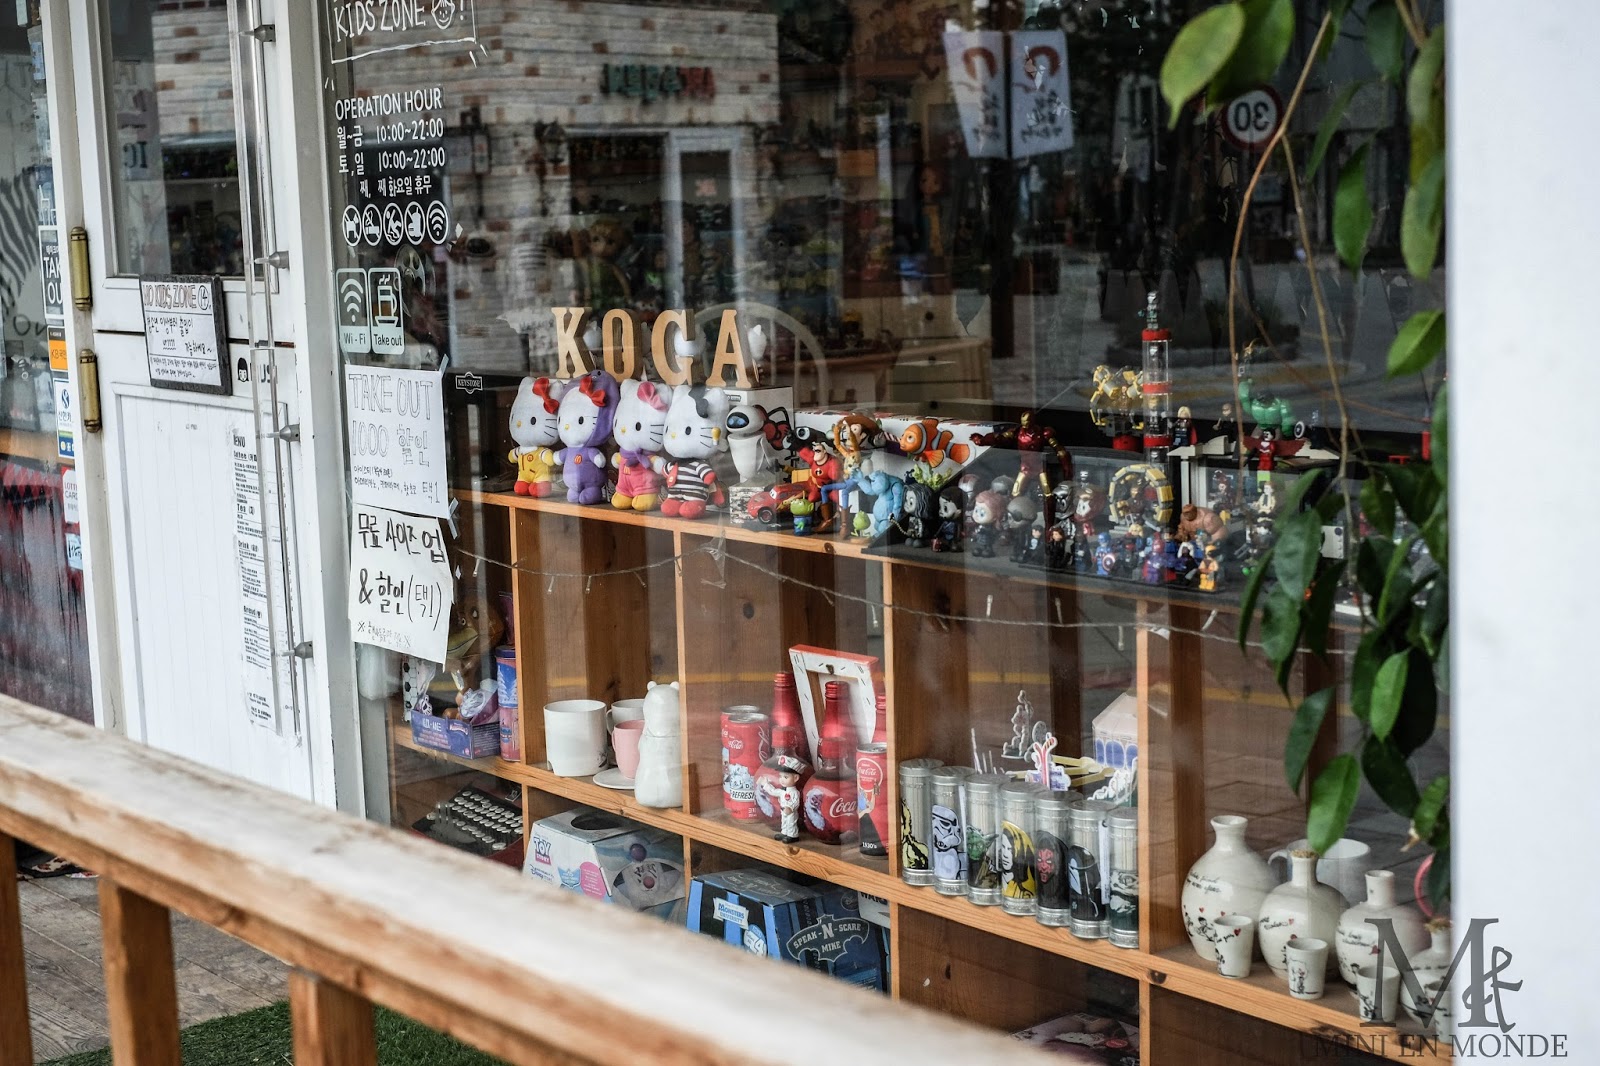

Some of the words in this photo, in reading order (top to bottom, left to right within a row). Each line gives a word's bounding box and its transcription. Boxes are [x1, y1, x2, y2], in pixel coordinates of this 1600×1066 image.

[334, 3, 376, 42] KIDS
[380, 0, 426, 32] ZONE
[335, 92, 401, 121] OPERATION
[404, 87, 442, 113] HOUR
[376, 117, 445, 144] 10:00~22:00
[378, 146, 446, 172] 10:00~22:00
[388, 175, 413, 197] 화요일
[414, 174, 432, 195] 휴무
[43, 256, 61, 279] TAK
[47, 281, 62, 305] OU
[155, 284, 172, 310] KIDS
[173, 284, 197, 309] ZONE
[373, 333, 390, 346] Take
[390, 334, 402, 346] out
[552, 306, 753, 388] KOGA
[349, 373, 393, 414] TAKE
[396, 377, 433, 421] OUT
[352, 420, 390, 458] 1000
[396, 423, 430, 468] 할인
[65, 481, 78, 490] LOTT
[358, 513, 383, 548] 무료
[385, 517, 421, 555] 사이즈
[422, 528, 446, 563] 업
[358, 568, 373, 605] &
[533, 836, 551, 857] TOY
[718, 903, 745, 919] MONSTERS
[793, 921, 818, 949] SPEAK
[838, 923, 861, 932] SCARE
[821, 941, 842, 953] MIKE
